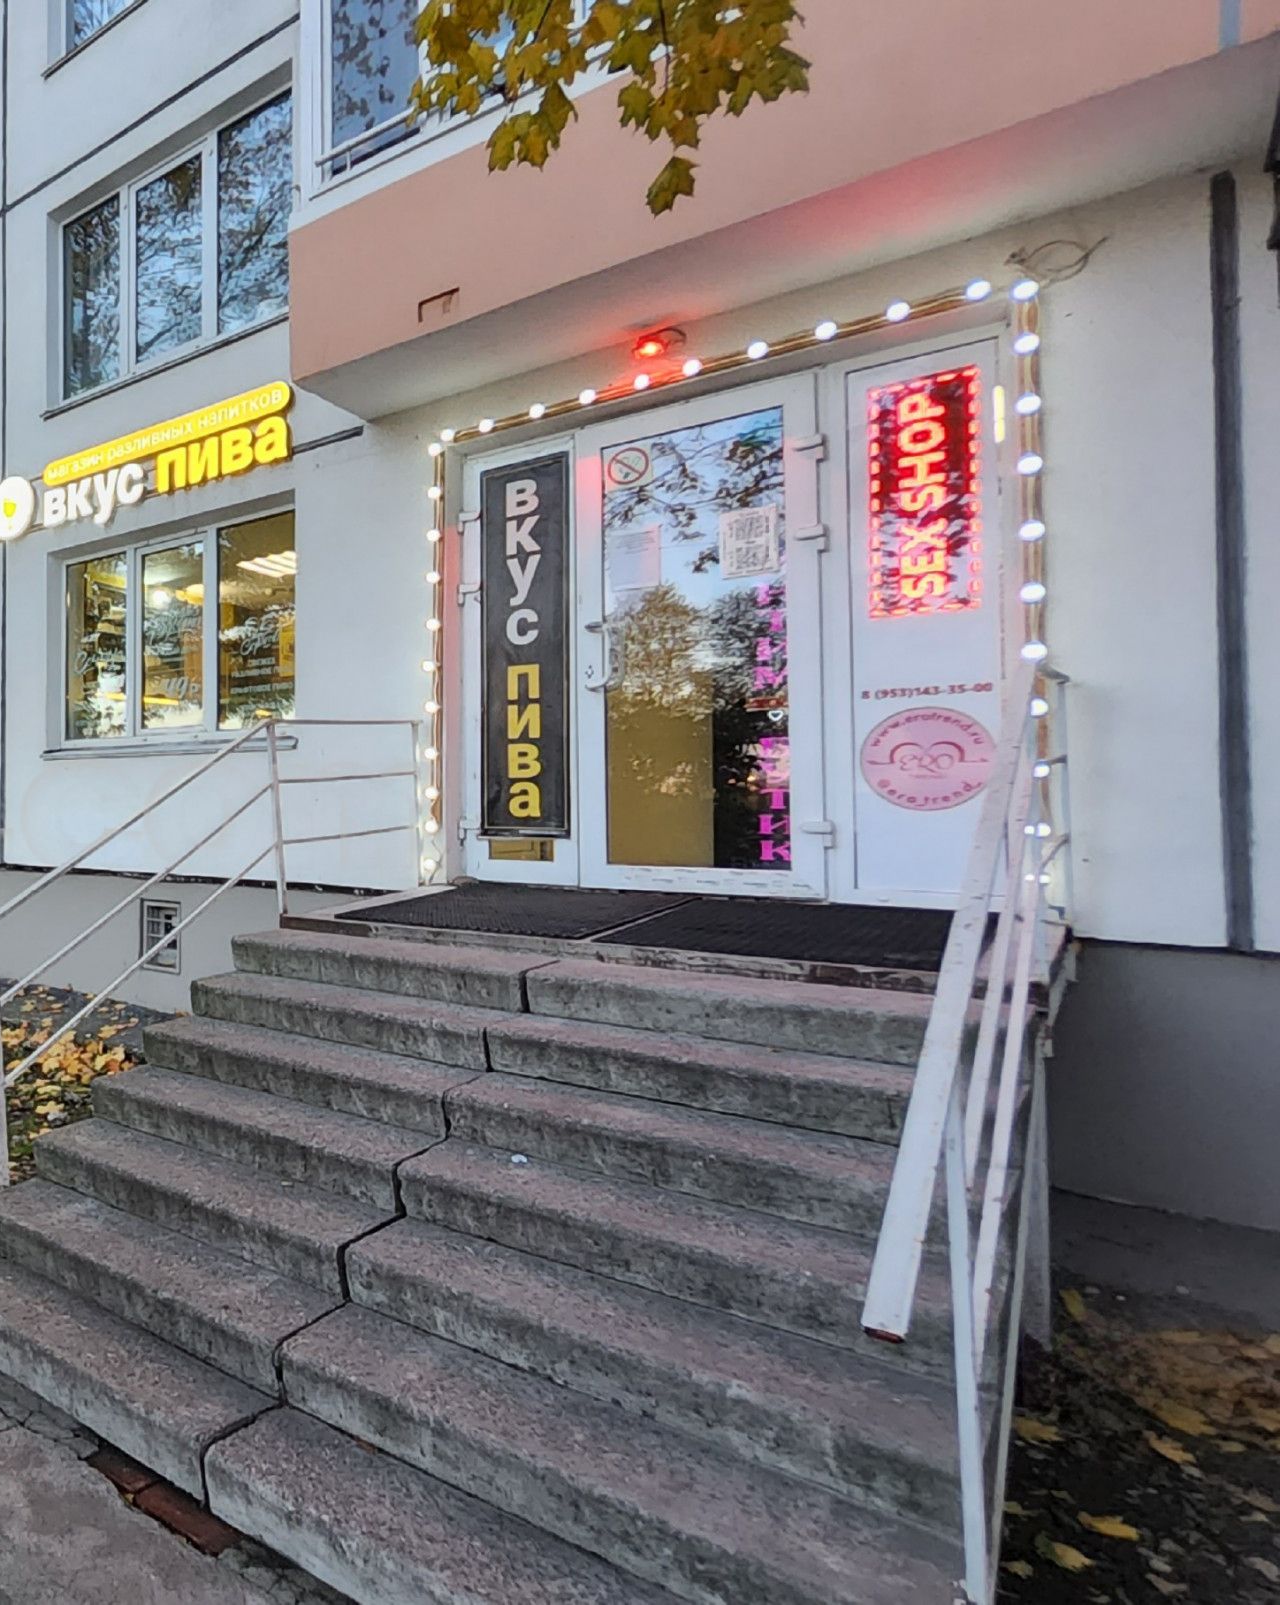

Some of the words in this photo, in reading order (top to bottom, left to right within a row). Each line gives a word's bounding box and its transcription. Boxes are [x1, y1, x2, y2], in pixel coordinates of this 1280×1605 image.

[106, 422, 195, 463] разливных
[198, 387, 284, 430] напитков
[896, 391, 947, 513] SHOP
[898, 517, 948, 599] SEX
